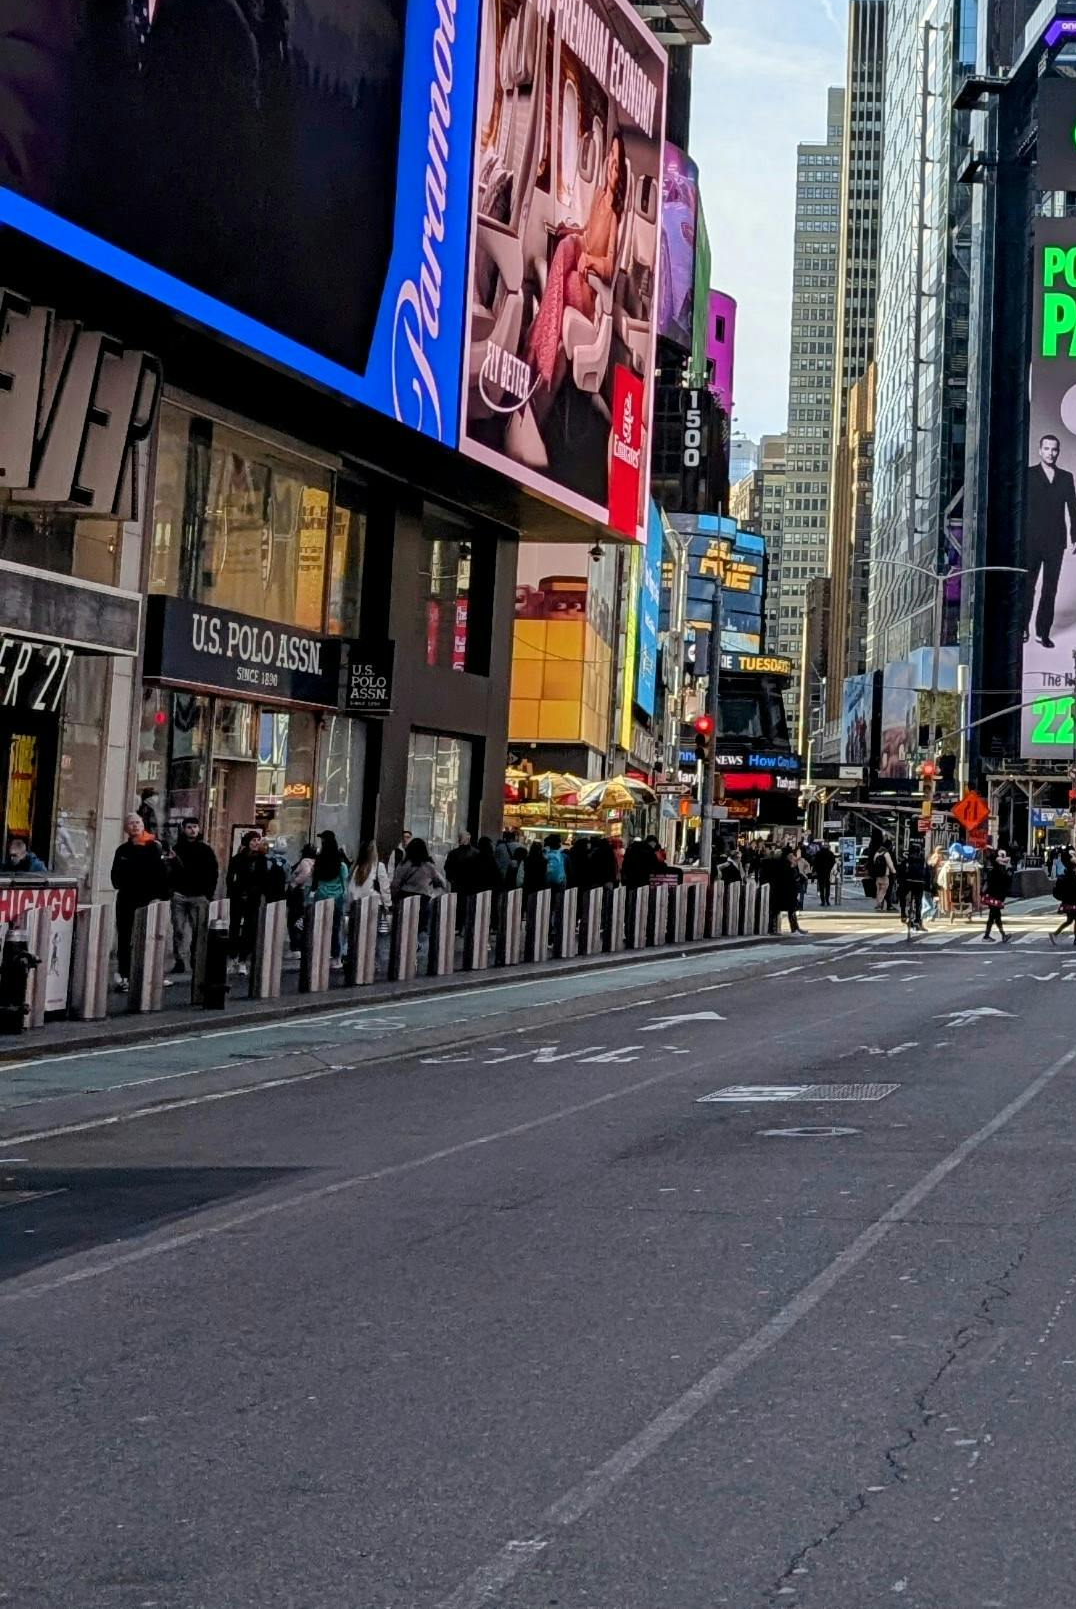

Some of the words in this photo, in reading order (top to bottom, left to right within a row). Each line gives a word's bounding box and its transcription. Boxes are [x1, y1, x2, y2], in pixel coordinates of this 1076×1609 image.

[609, 37, 657, 139] ECONOMY
[484, 340, 501, 384] FLY
[500, 350, 531, 400] BETTER
[683, 390, 701, 468] 1500
[192, 613, 223, 655] U.S.
[226, 621, 274, 665] POLO
[276, 634, 323, 676] ASSN.
[32, 647, 75, 712] 21
[236, 666, 259, 684] SINCE
[261, 672, 278, 687] 1890
[352, 665, 376, 676] U.S.
[1042, 673, 1062, 687] The
[351, 676, 387, 688] POLO
[350, 688, 389, 700] ASSN.
[748, 754, 776, 767] How
